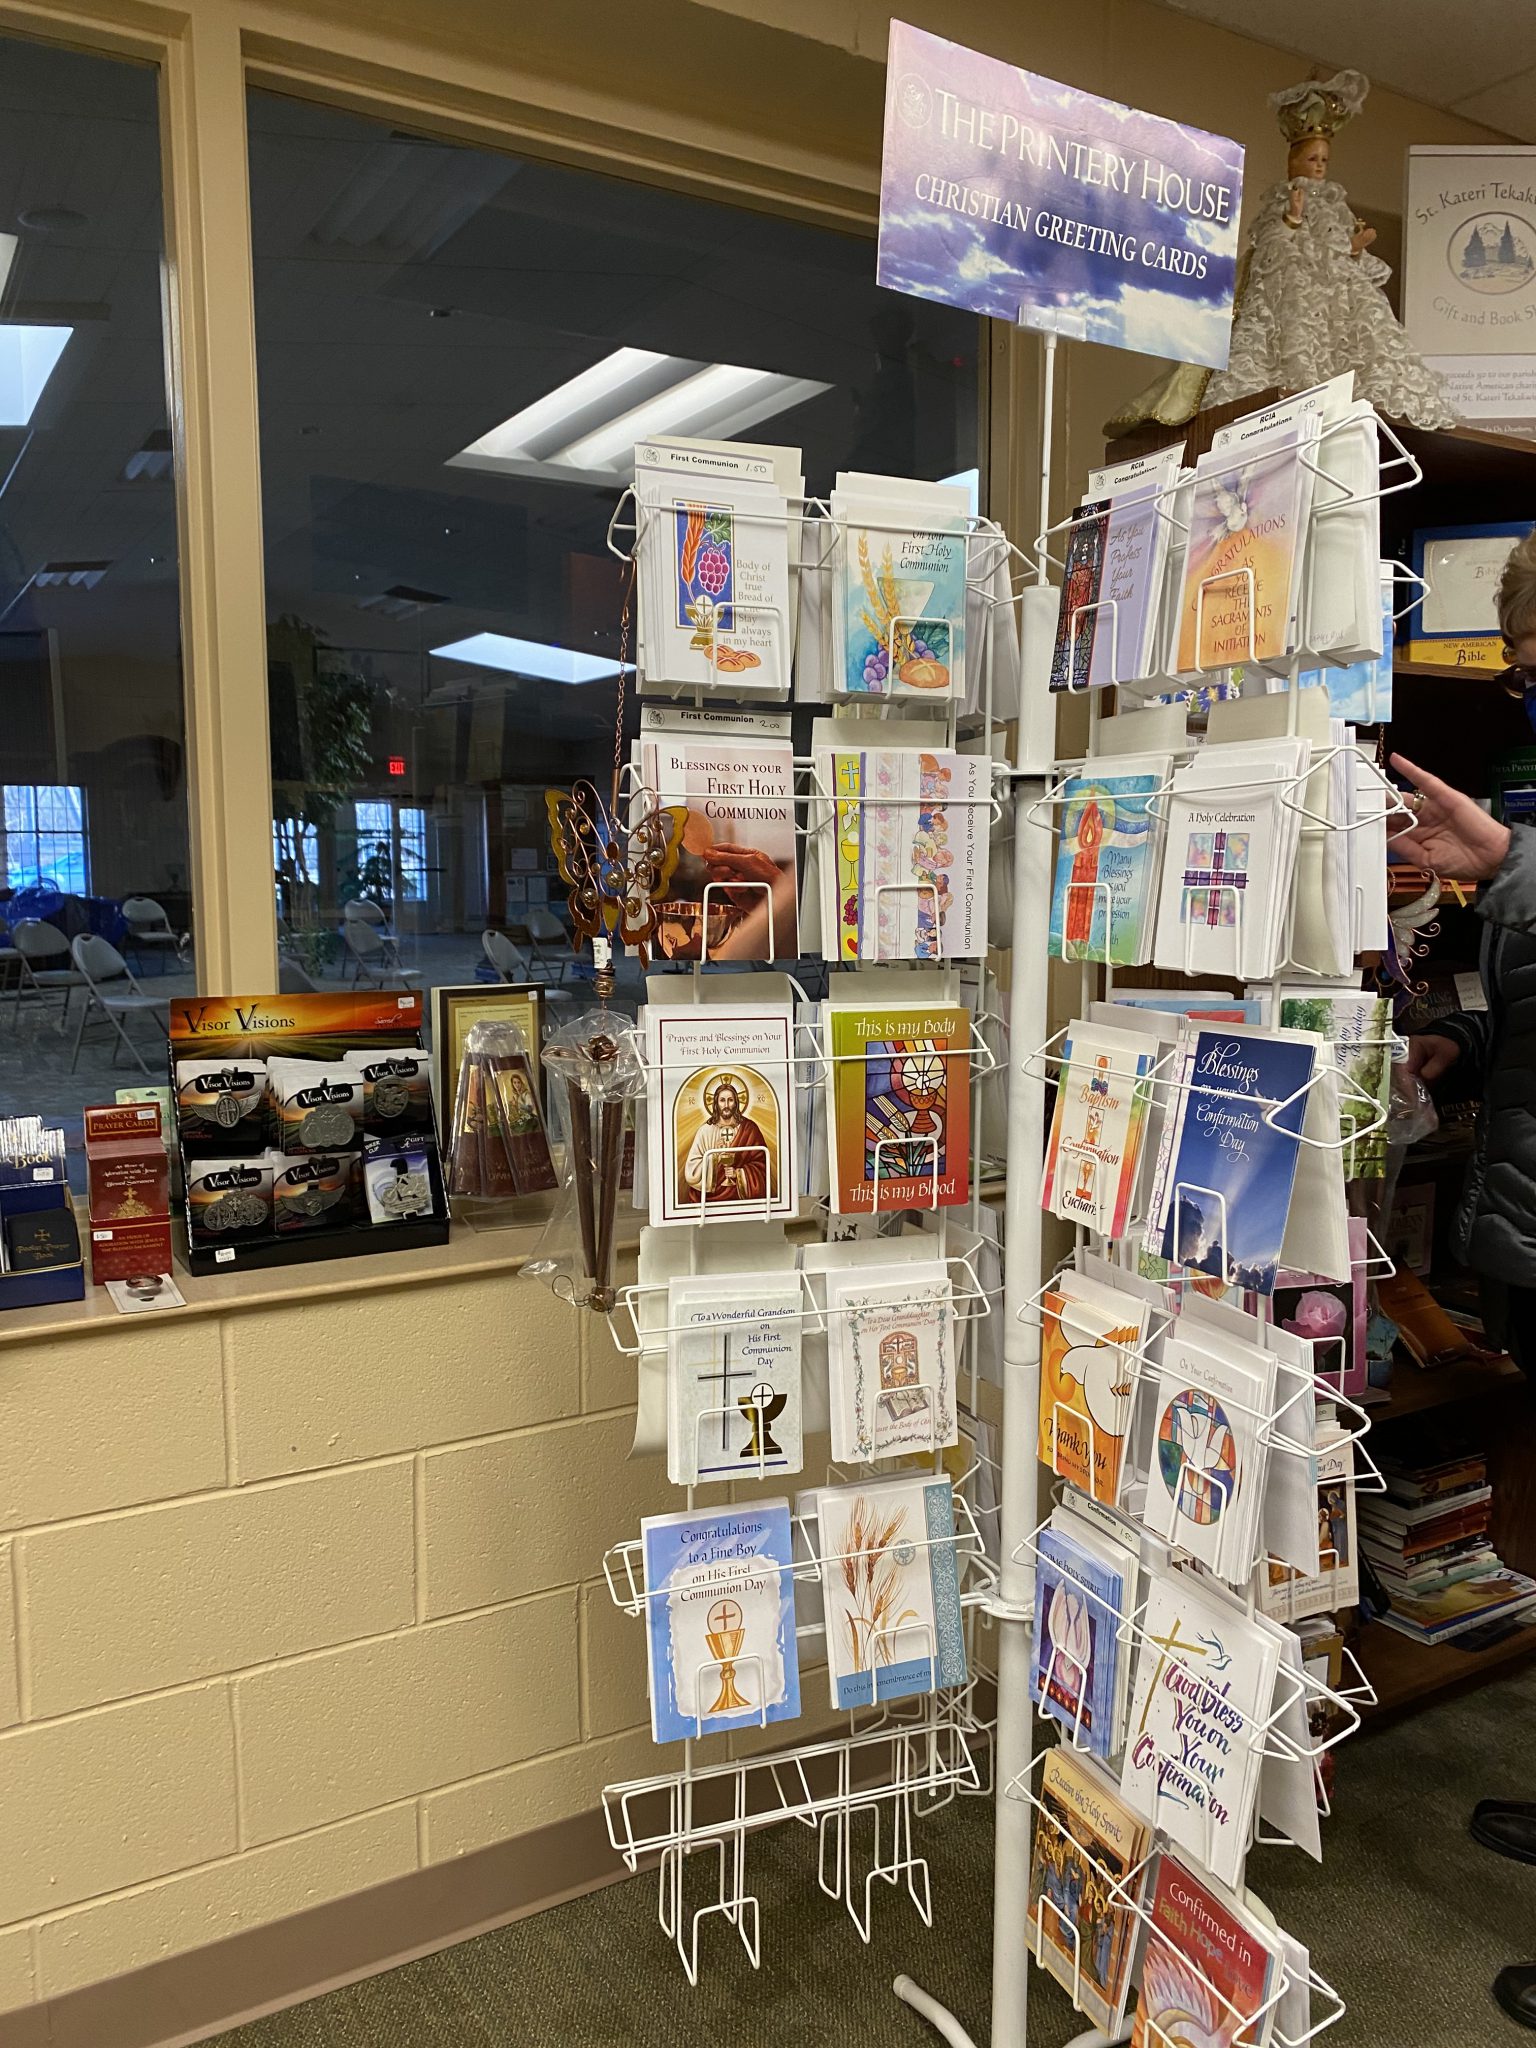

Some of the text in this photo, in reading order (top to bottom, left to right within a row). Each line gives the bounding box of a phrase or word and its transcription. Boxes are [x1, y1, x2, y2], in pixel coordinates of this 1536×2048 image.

[935, 88, 1232, 223] THE PRINTERY HOUSE
[1438, 183, 1486, 209] Kateri
[914, 173, 1208, 280] CHRISTIAN GREETING CARDS
[1432, 295, 1523, 326] Gift and Book
[1258, 411, 1277, 424] RCIA
[1239, 416, 1293, 441] Congratulations
[670, 453, 740, 469] First Communion
[1129, 460, 1145, 471] RCIA
[1113, 465, 1159, 484] Congratulations
[901, 541, 953, 560] First Holy
[736, 559, 771, 572] Body of
[899, 557, 949, 573] Communion
[739, 571, 766, 582] Christ
[744, 582, 763, 591] true
[738, 591, 774, 603] Bread of
[737, 613, 758, 626] Stay
[741, 625, 772, 638] always
[1234, 623, 1248, 636] OF
[723, 637, 773, 649] in my heart
[1461, 640, 1497, 648] AMERICAN
[1455, 649, 1486, 666] Bible
[680, 711, 755, 724] First Communion
[389, 761, 405, 775] EXIT
[670, 757, 783, 774] BLESSINGS ON YOUR
[968, 762, 977, 775] As
[707, 777, 787, 796] FIRST HOLY
[967, 777, 977, 798] You
[705, 800, 788, 820] COMMUNION
[1214, 811, 1256, 823] Celebration
[965, 842, 975, 866] Your
[965, 869, 975, 891] First
[1101, 864, 1134, 884] Blessings
[1116, 897, 1132, 907] your
[963, 893, 974, 950] Communion
[182, 1003, 296, 1034] Visor Visions
[854, 1017, 956, 1038] This is my Body
[666, 1033, 697, 1045] Prayers
[699, 1033, 713, 1042] and
[714, 1032, 751, 1045] Blessings
[763, 1032, 783, 1041] Your
[680, 1045, 770, 1058] First Holy Communion
[368, 1063, 415, 1079] Visor Visions
[1196, 1041, 1260, 1094] Blessings
[200, 1075, 251, 1090] Visor Visions
[301, 1087, 350, 1105] Visor Visions
[1078, 1083, 1121, 1110] Baptism
[93, 1119, 155, 1131] PRAYER CARDS
[1196, 1103, 1260, 1137] Confirmation
[1219, 1126, 1250, 1163] Day
[207, 1172, 258, 1189] Visor Visions
[289, 1163, 337, 1182] Visor Visions
[849, 1183, 915, 1202] This is my
[690, 1312, 705, 1322] To
[711, 1309, 756, 1320] Wonderful
[757, 1307, 796, 1317] Grandson
[748, 1333, 782, 1343] His First
[741, 1345, 793, 1356] Communion
[757, 1357, 774, 1369] Day
[1326, 1457, 1346, 1473] Day
[1087, 1501, 1117, 1527] Confirmation
[680, 1522, 763, 1544] Congratulations
[688, 1543, 757, 1564] to a Fine Boy
[692, 1574, 705, 1584] on
[708, 1568, 726, 1581] His
[680, 1578, 767, 1602] Communion Day
[843, 1686, 854, 1695] Do
[1172, 1696, 1232, 1756] You on
[1179, 1733, 1225, 1785] Your
[1100, 1811, 1123, 1843] Spirit
[1158, 1896, 1224, 1962] Faith Hope
[1169, 1882, 1252, 1968] Confirmed in
